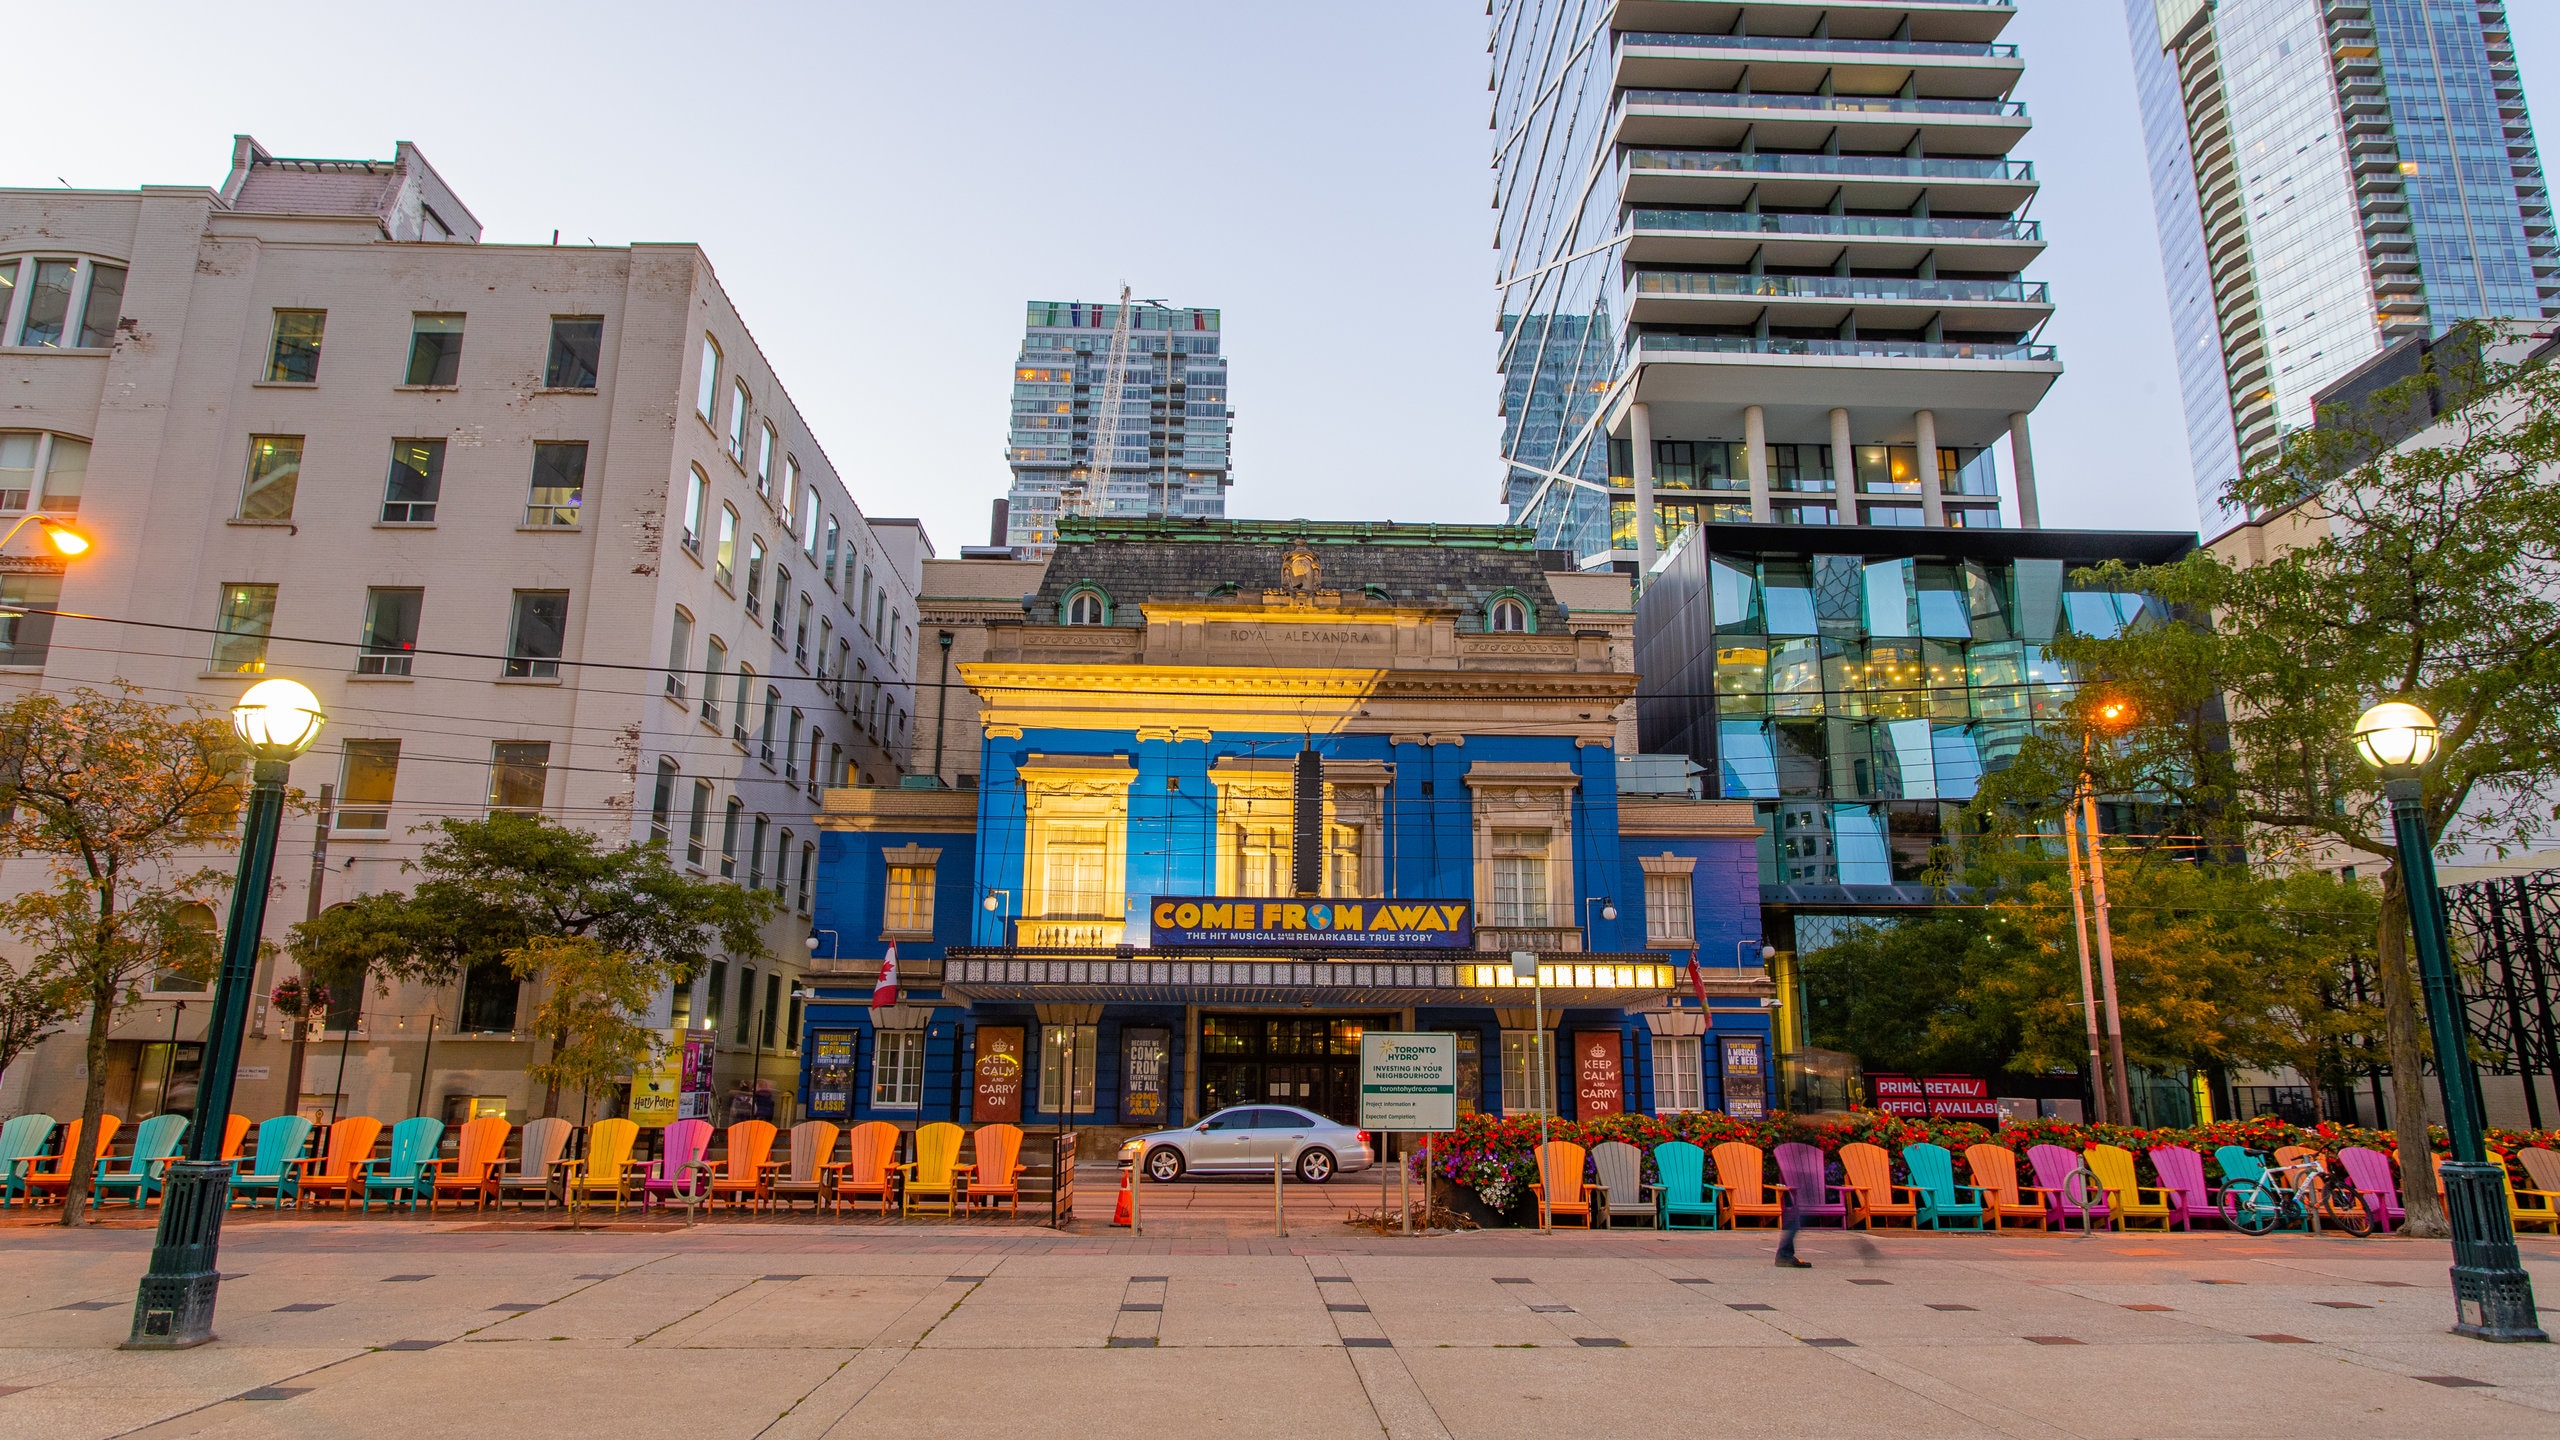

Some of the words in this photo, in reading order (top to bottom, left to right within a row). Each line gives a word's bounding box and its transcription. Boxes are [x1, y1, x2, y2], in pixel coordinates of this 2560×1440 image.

[1231, 630, 1273, 640] ROYAL
[1284, 632, 1370, 642] ALEXANDRA
[1154, 902, 1255, 930] COME
[1368, 904, 1466, 932] AWAY
[1210, 932, 1227, 940] HIT
[1230, 932, 1276, 940] MUSICAL
[818, 1045, 850, 1054] INSPIRING
[1457, 1041, 1475, 1050] ERFUL
[1131, 1047, 1159, 1060] COME
[1584, 1060, 1612, 1069] KEEP
[1728, 1056, 1739, 1065] WE
[1741, 1056, 1757, 1065] NEED
[982, 1066, 1014, 1075] CALM
[1130, 1061, 1158, 1074] FROM
[1583, 1072, 1614, 1080] CALM
[980, 1084, 1016, 1093] CARRY
[1130, 1081, 1142, 1091] WE
[1144, 1081, 1157, 1091] ALL
[1880, 1082, 1922, 1093] PRIME
[1926, 1082, 1980, 1095] RETAIL/
[1581, 1089, 1617, 1098] CARRY
[634, 1096, 655, 1110] Harry
[655, 1095, 675, 1108] Potter
[988, 1096, 1006, 1105] ON
[814, 1100, 845, 1111] CLASSIC
[1592, 1101, 1608, 1110] ON
[1935, 1102, 1998, 1113] AVAILABL
